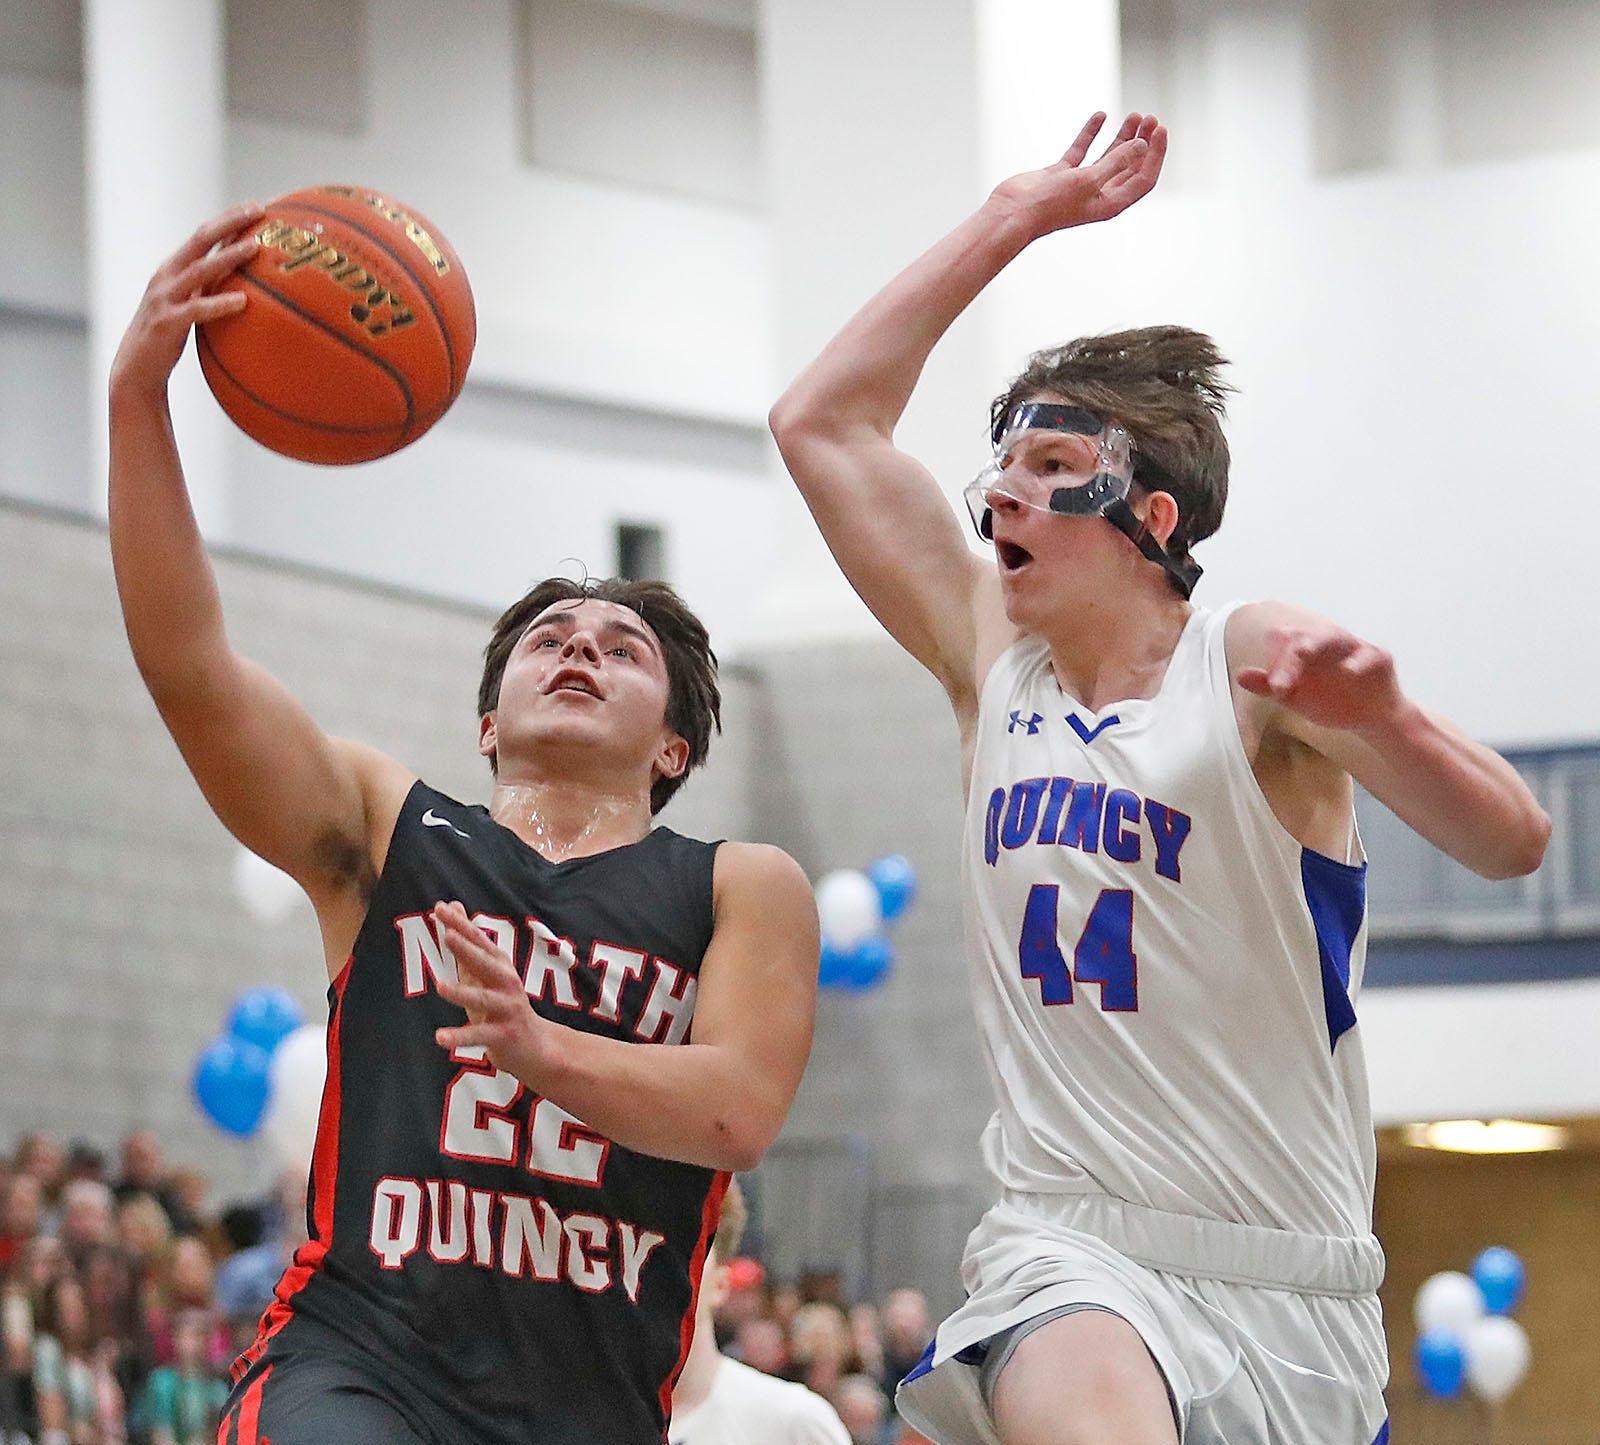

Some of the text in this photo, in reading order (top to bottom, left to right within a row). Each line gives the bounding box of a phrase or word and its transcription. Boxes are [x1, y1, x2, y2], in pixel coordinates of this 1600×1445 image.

[984, 776, 1192, 883] QUINCY
[1018, 884, 1139, 1012] 44
[440, 1045, 609, 1186] 22
[369, 1178, 664, 1302] QUINCY
